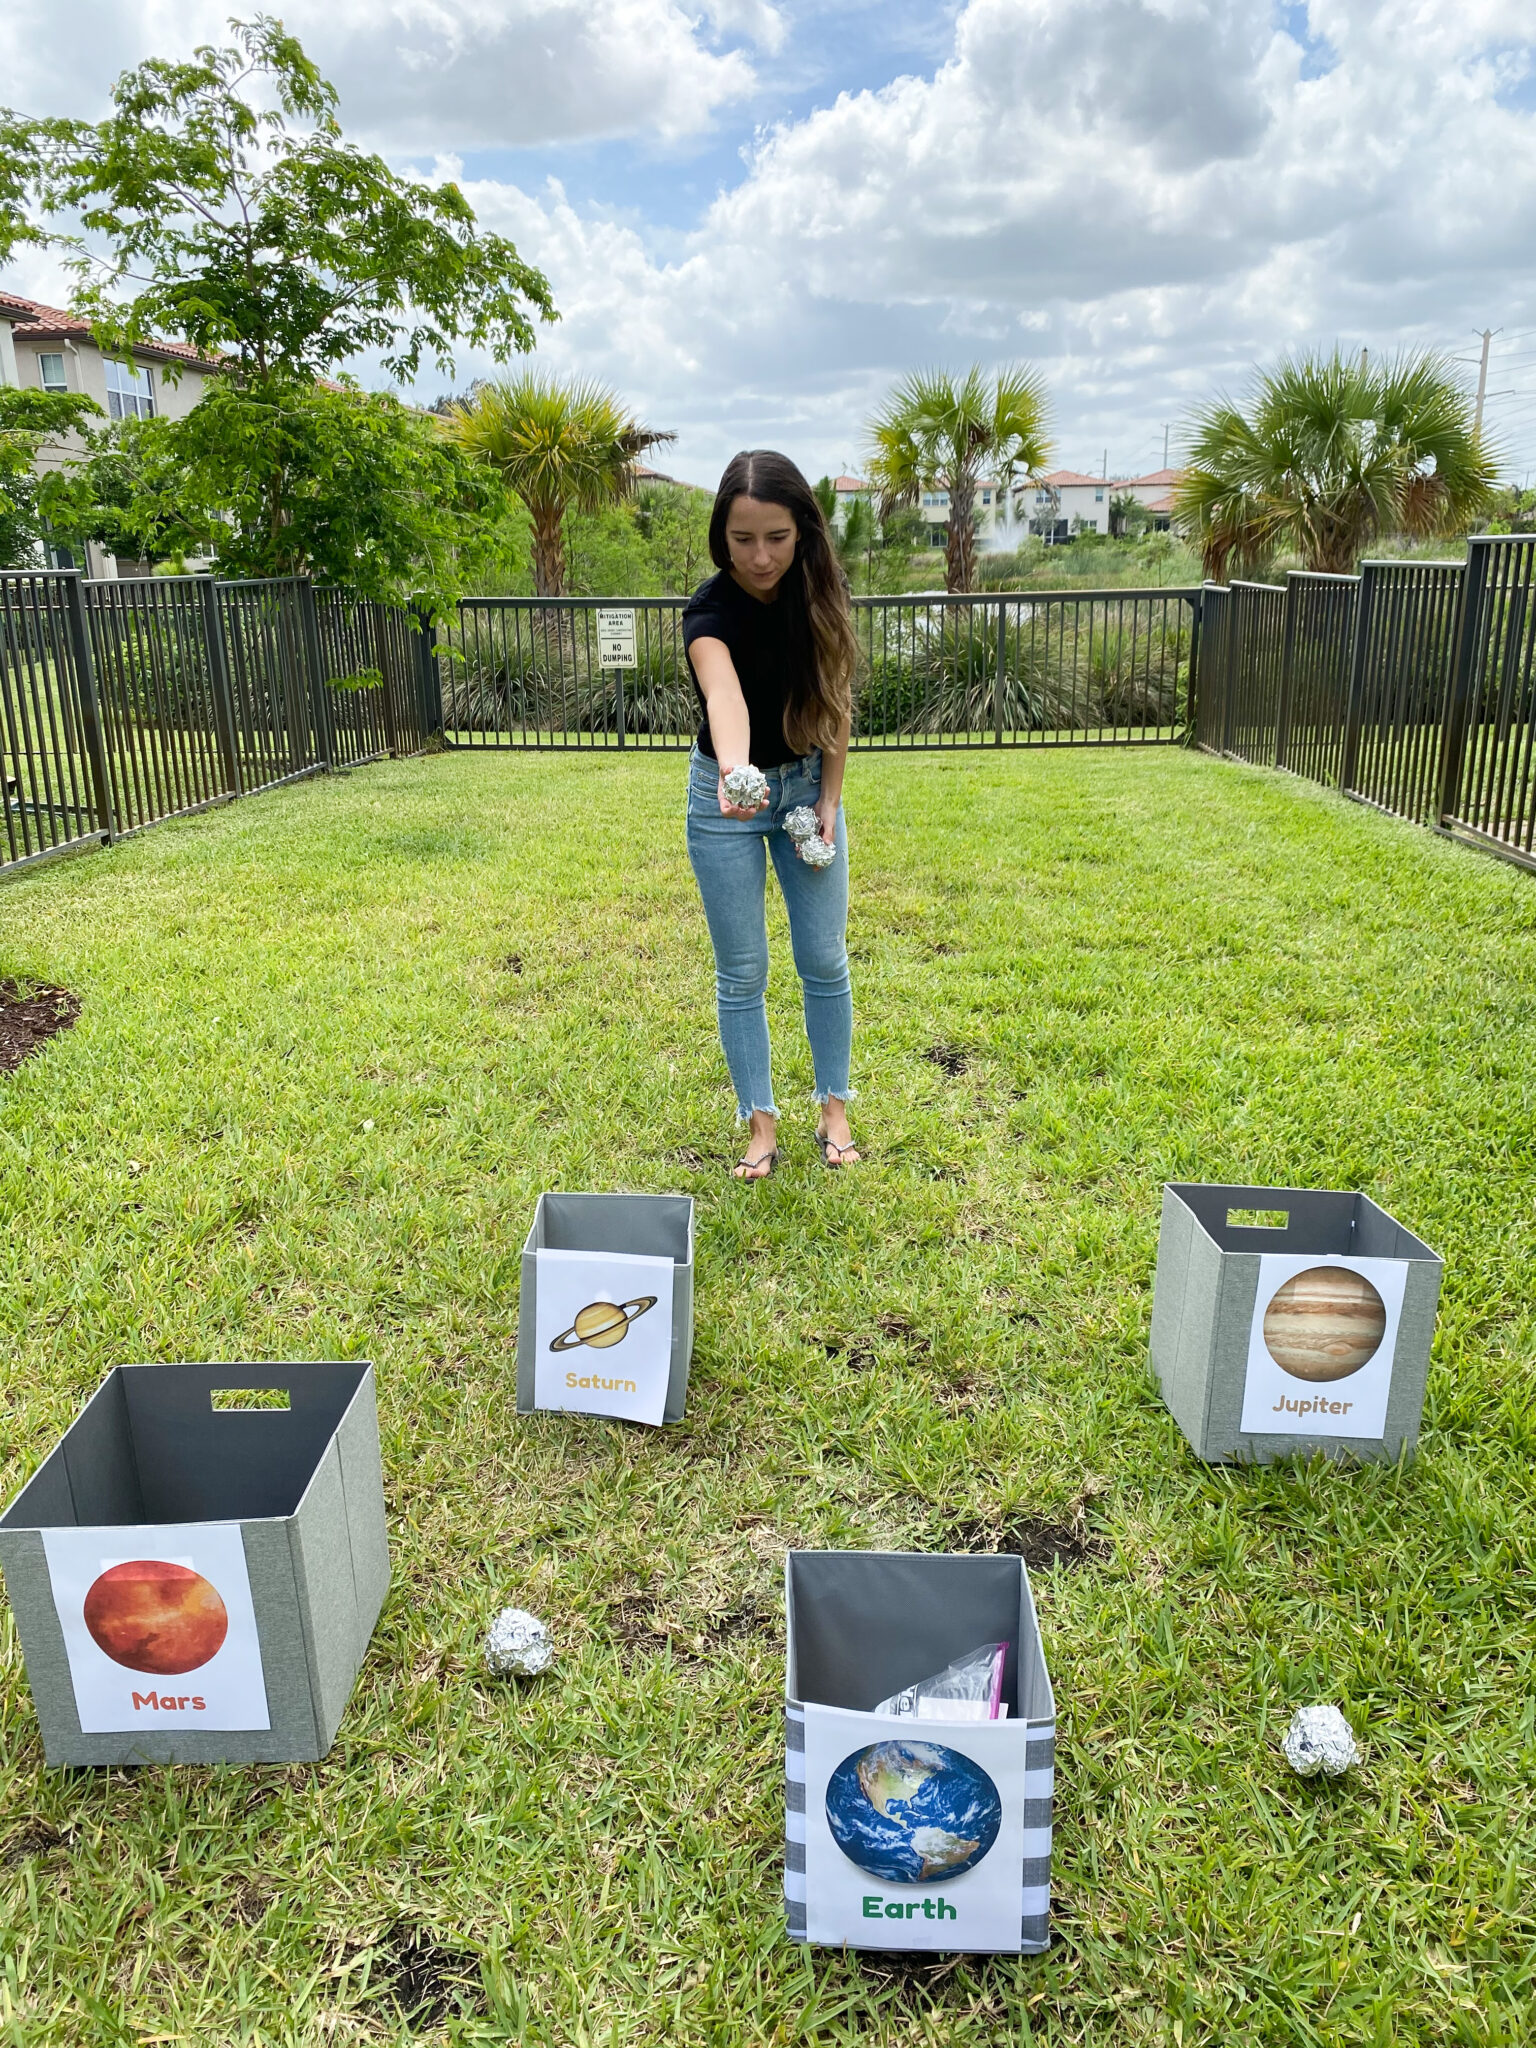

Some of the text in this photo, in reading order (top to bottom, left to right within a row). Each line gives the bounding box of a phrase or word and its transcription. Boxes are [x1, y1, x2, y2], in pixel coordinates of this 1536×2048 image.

[566, 1372, 636, 1393] Saturn
[1272, 1395, 1353, 1417] Jupiter
[131, 1691, 206, 1711] Mars
[862, 1895, 957, 1921] Earth
